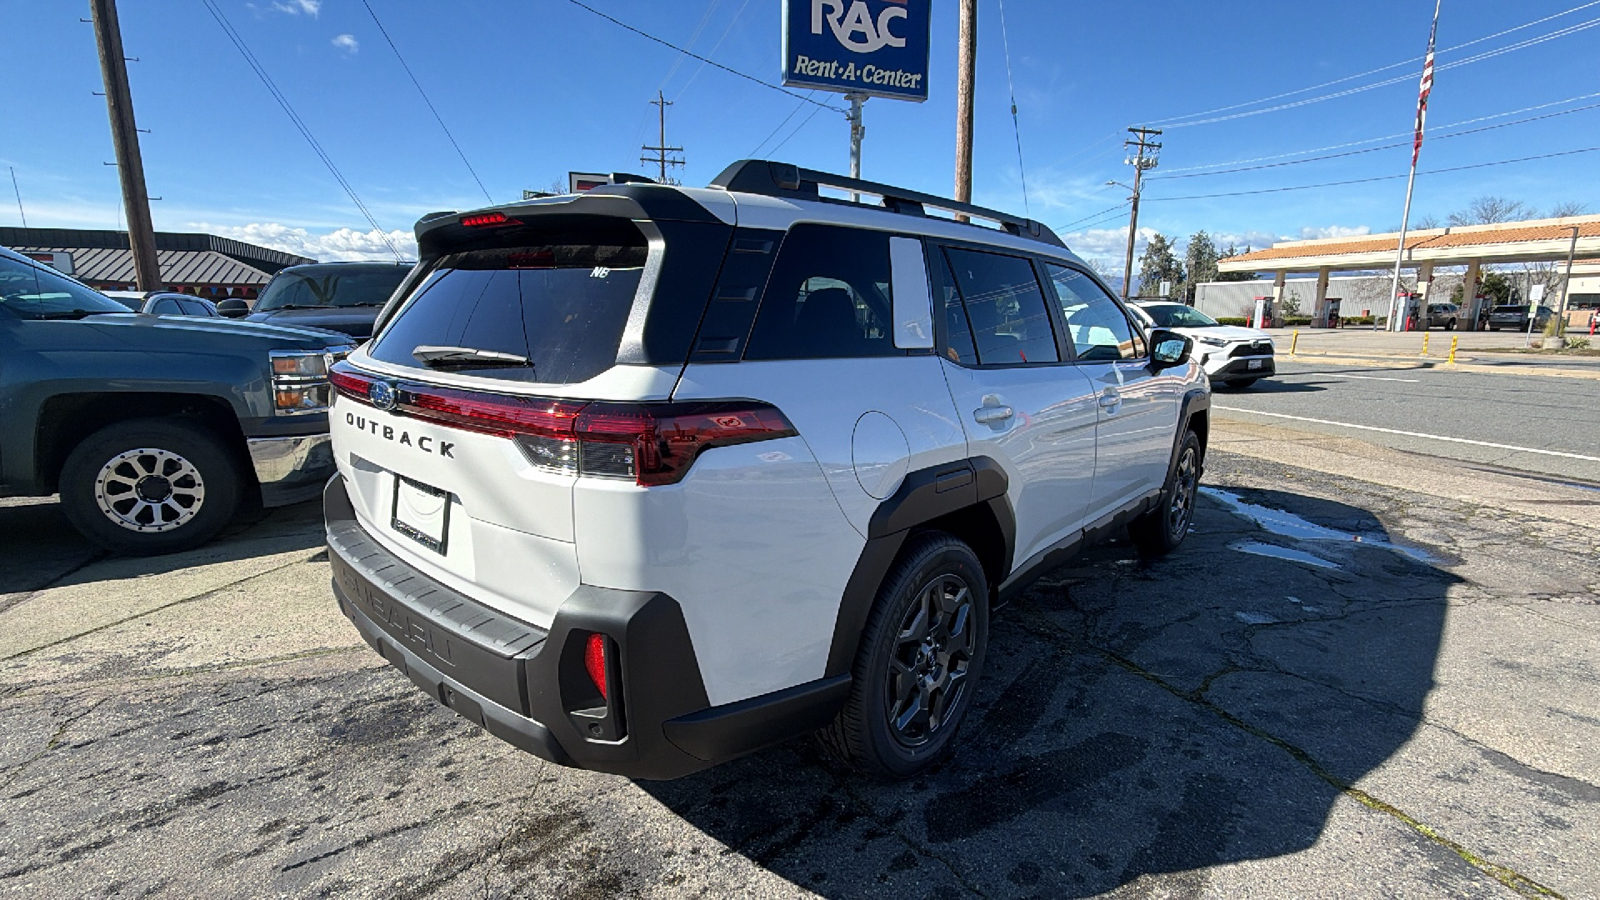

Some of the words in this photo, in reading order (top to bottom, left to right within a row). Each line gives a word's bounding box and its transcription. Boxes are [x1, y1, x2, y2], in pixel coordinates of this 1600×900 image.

[811, 0, 907, 53] RAC
[346, 412, 455, 459] OUTBACK
[342, 567, 457, 668] SUBARU
